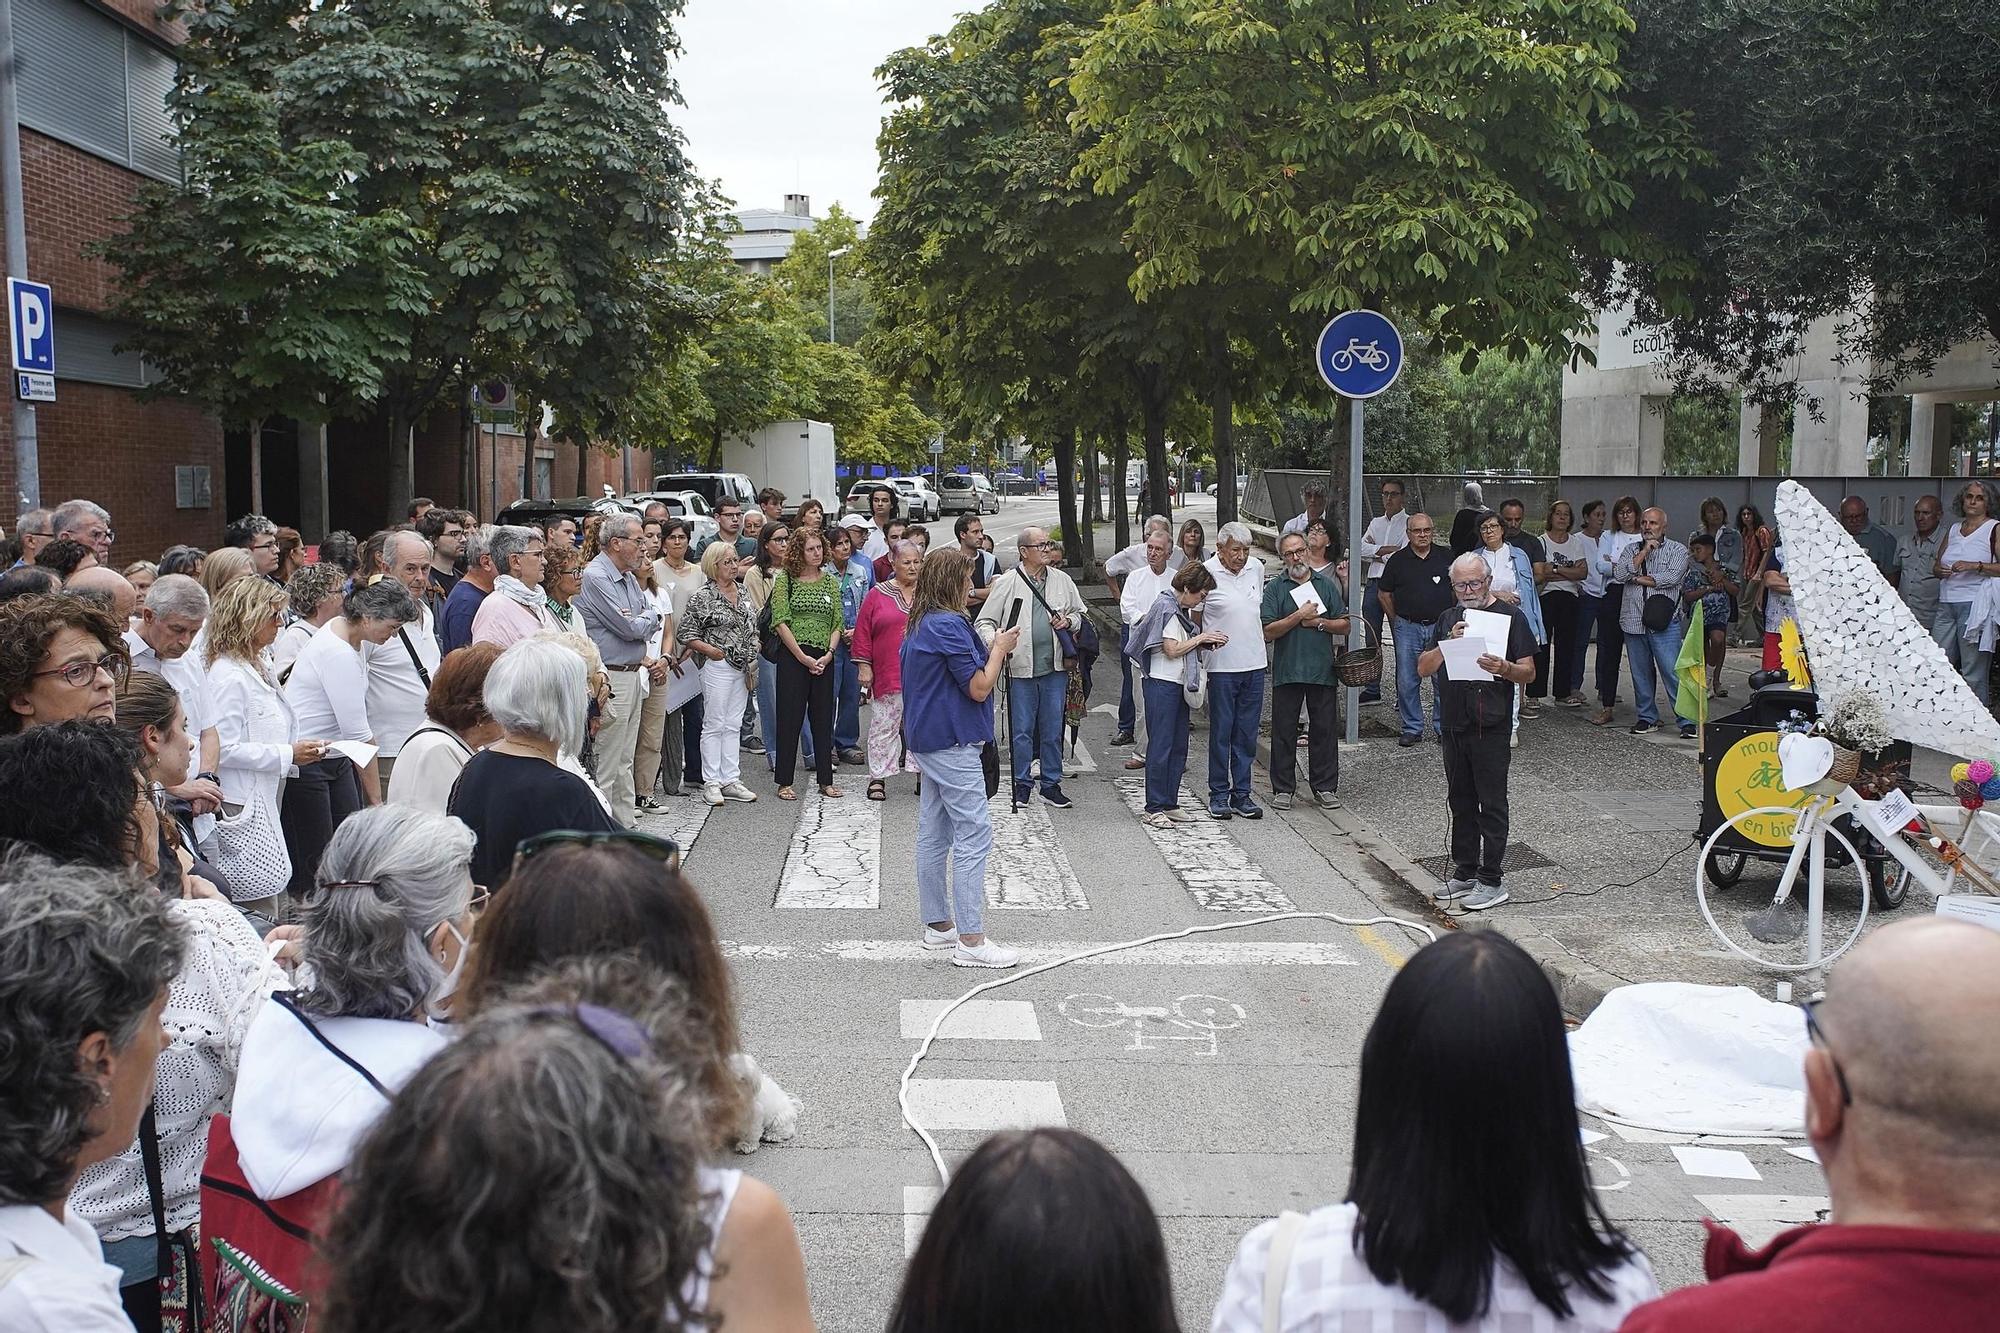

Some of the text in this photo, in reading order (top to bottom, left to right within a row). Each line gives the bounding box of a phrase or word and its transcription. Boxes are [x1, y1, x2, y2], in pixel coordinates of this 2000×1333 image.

[21, 291, 45, 361] P
[1633, 335, 1671, 354] ESCOLA
[1740, 741, 1777, 757] mou
[1743, 819, 1763, 835] en
